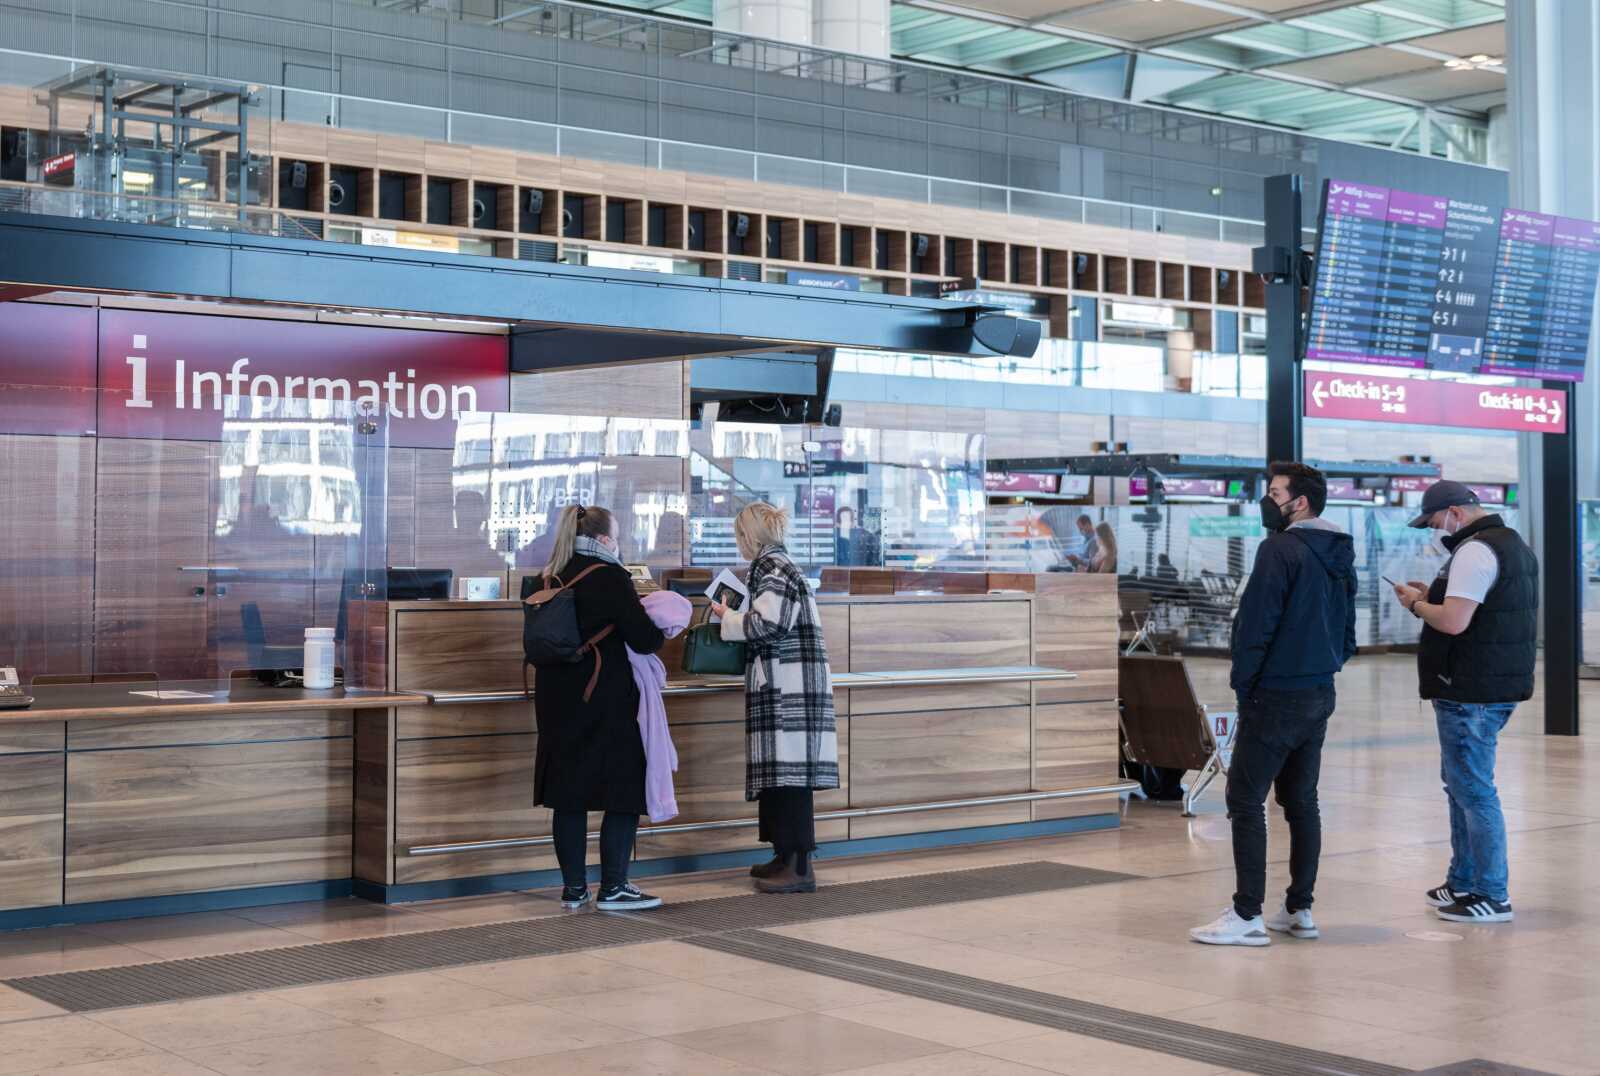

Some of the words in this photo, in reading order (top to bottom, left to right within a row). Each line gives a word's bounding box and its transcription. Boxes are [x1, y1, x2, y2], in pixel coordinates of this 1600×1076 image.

[1447, 269, 1456, 283] 2
[1444, 290, 1452, 304] 4
[1441, 311, 1449, 326] 5
[175, 358, 477, 421] Information
[1330, 379, 1380, 400] Check-in
[1479, 391, 1524, 411] Check-in
